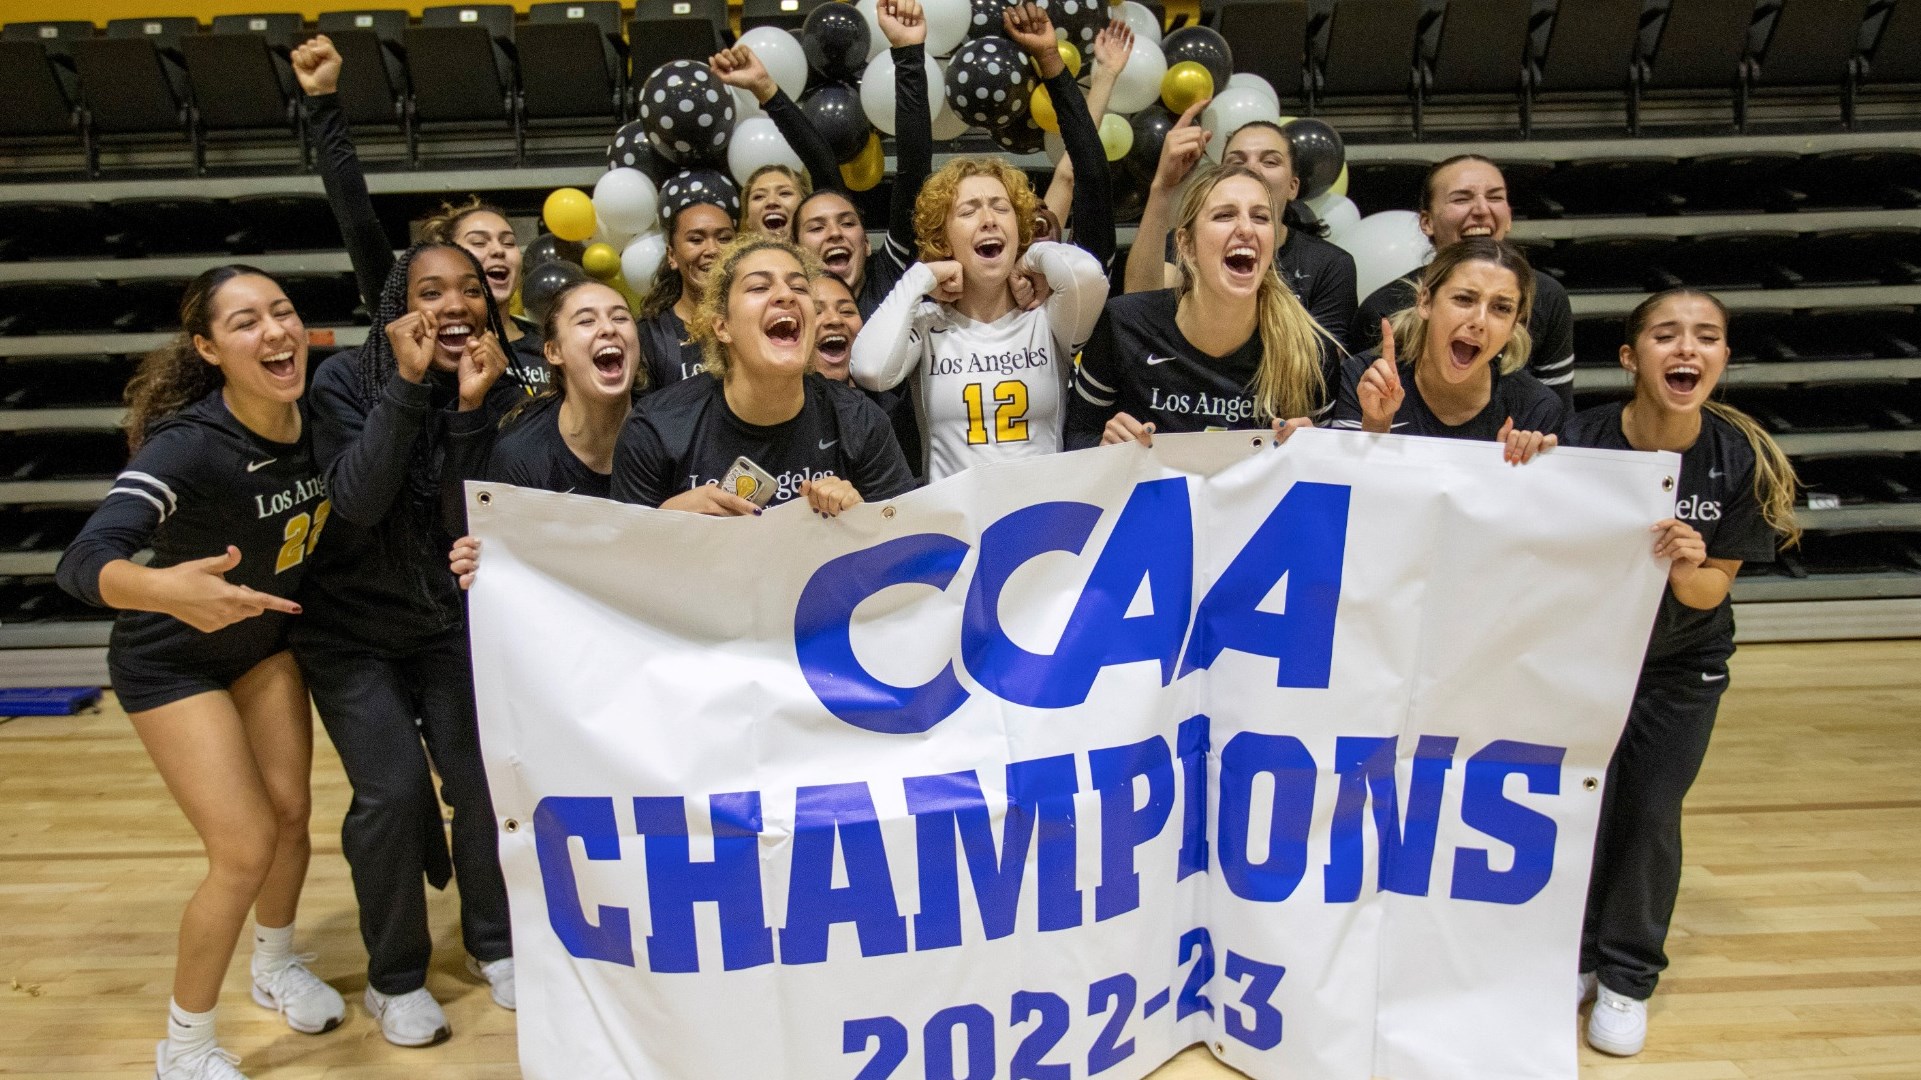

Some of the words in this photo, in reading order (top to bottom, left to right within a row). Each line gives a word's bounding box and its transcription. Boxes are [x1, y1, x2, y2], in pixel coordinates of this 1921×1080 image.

[928, 354, 963, 376] Los
[967, 346, 1048, 376] Angeles
[962, 379, 1029, 446] 12
[1150, 387, 1190, 414] Los
[254, 489, 293, 519] Los
[1675, 494, 1722, 521] eles
[794, 476, 1352, 734] CCAA
[532, 713, 1568, 974] CHAMPIONS
[842, 926, 1287, 1080] 2022-23
